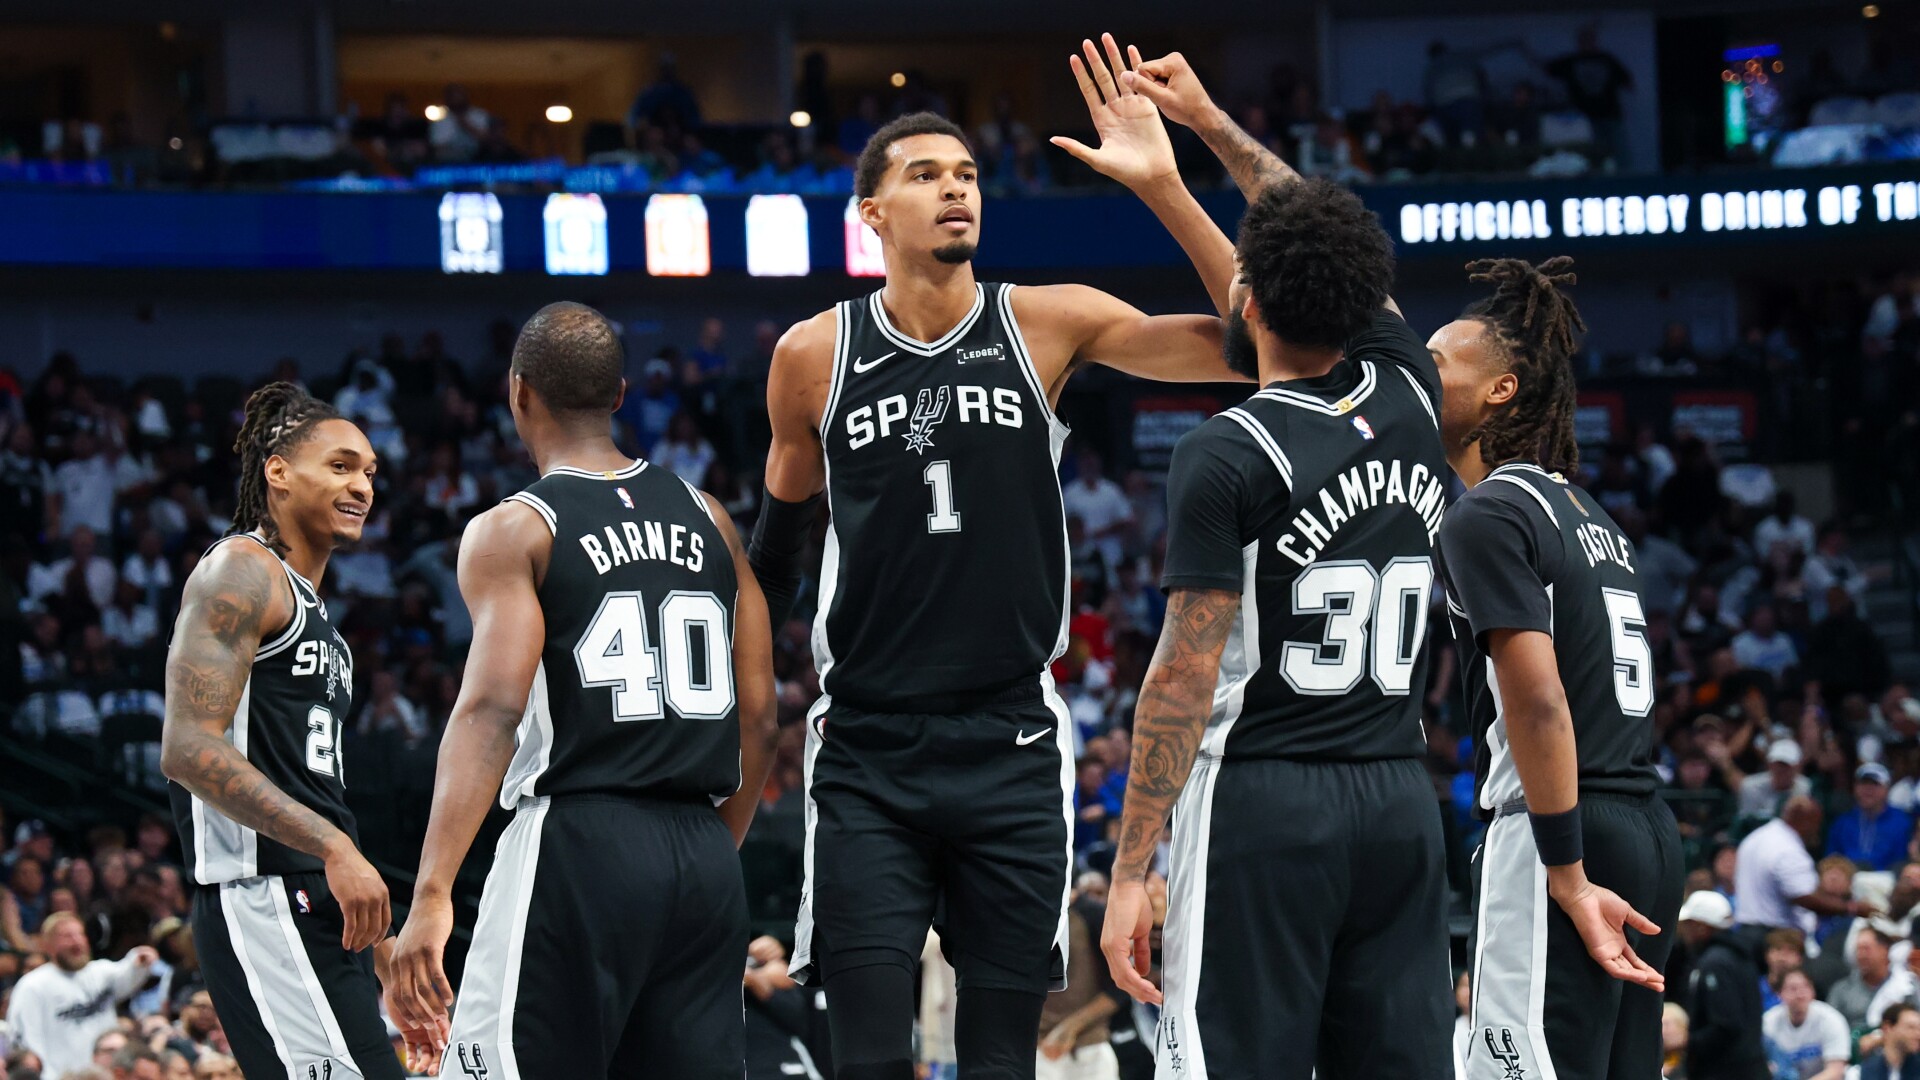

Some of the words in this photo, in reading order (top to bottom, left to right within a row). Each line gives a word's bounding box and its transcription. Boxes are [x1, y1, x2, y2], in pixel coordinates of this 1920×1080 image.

[1401, 199, 1552, 243] OFFICIAL
[1562, 194, 1689, 237] ENERGY
[1701, 188, 1807, 231] DRINK
[1818, 185, 1861, 225] OF
[1873, 181, 1920, 222] TH
[963, 348, 999, 360] LEDGER
[846, 385, 1023, 455] SPURS
[924, 460, 961, 533] 1
[579, 521, 704, 575] BARNES
[1576, 522, 1635, 574] CASTLE
[573, 590, 735, 722] 40
[1279, 556, 1434, 695] 30
[1601, 586, 1654, 717] 5
